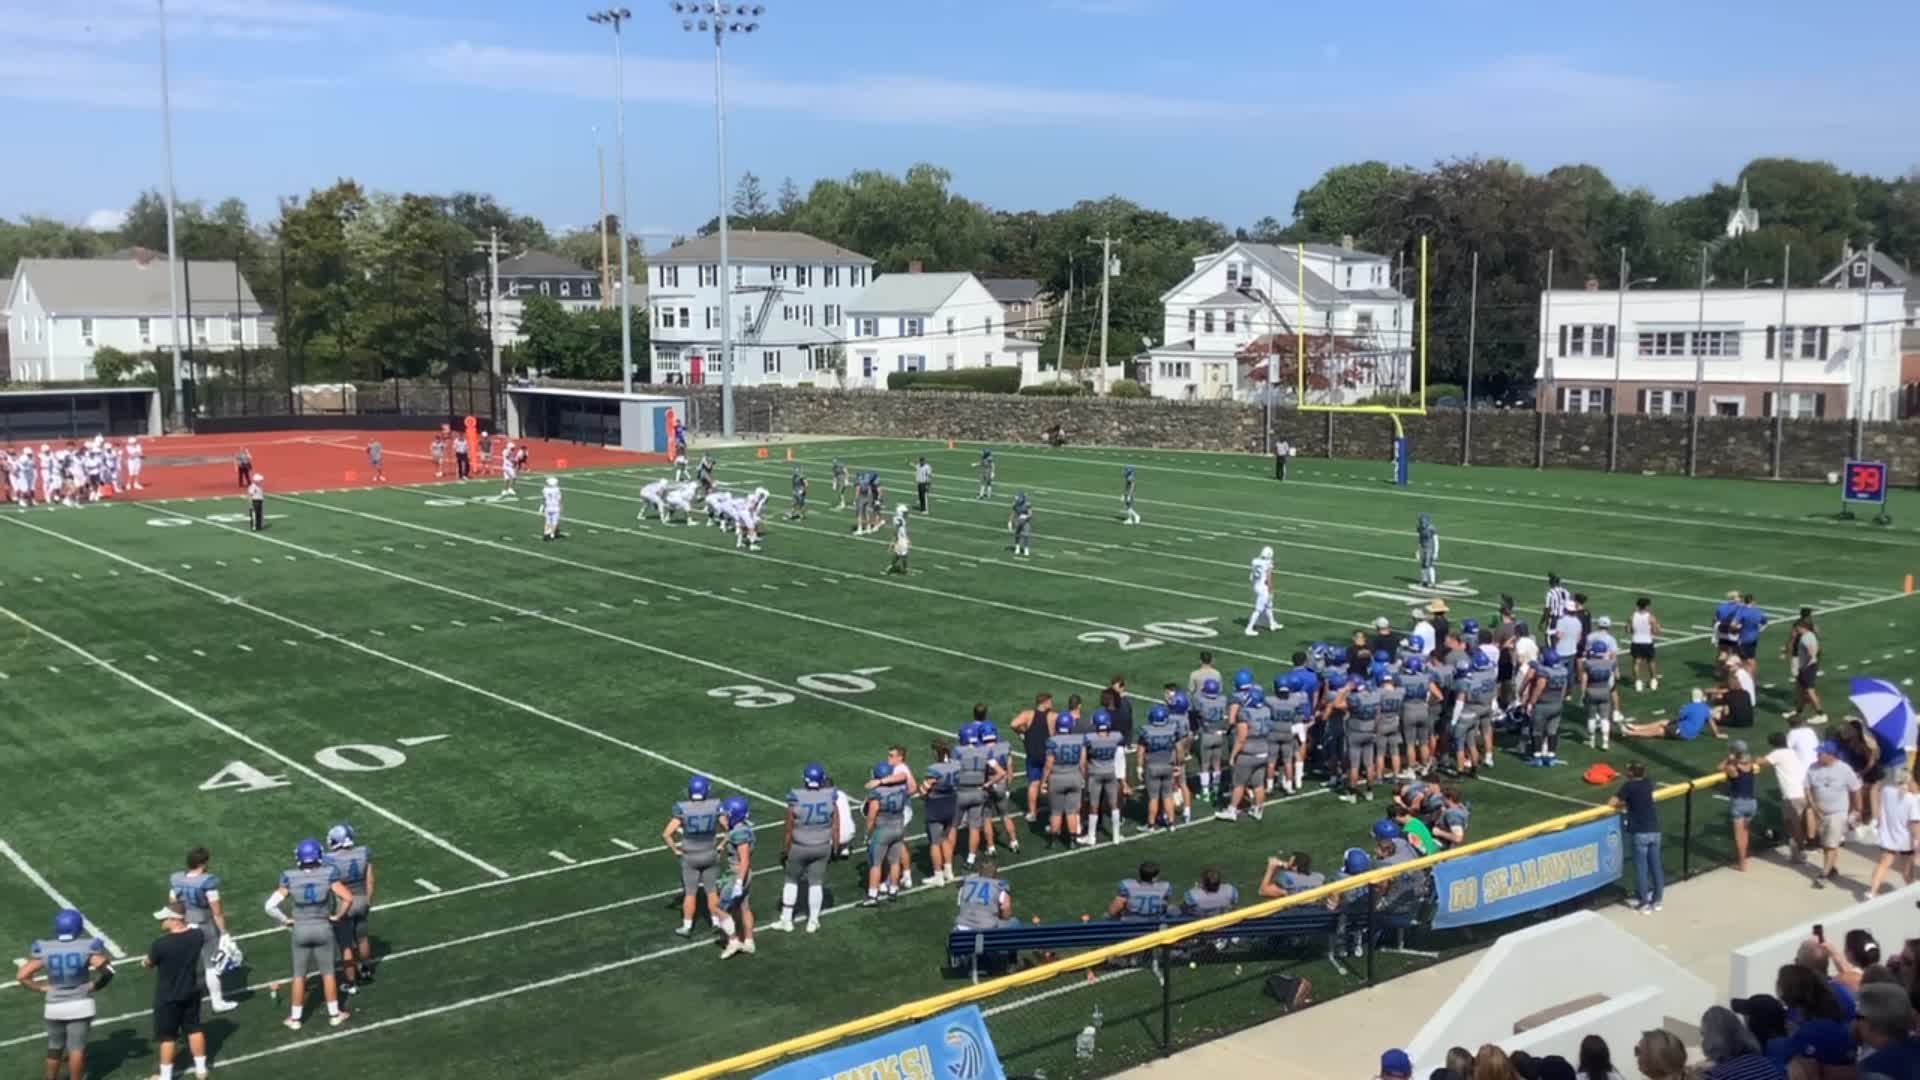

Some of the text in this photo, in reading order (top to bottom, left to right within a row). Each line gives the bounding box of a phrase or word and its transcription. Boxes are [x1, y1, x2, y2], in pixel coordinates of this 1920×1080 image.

[1077, 619, 1219, 651] 20
[707, 672, 877, 709] 30
[197, 743, 408, 793] 40
[800, 802, 828, 826] 75
[964, 880, 991, 906] 74
[48, 952, 81, 978] 99
